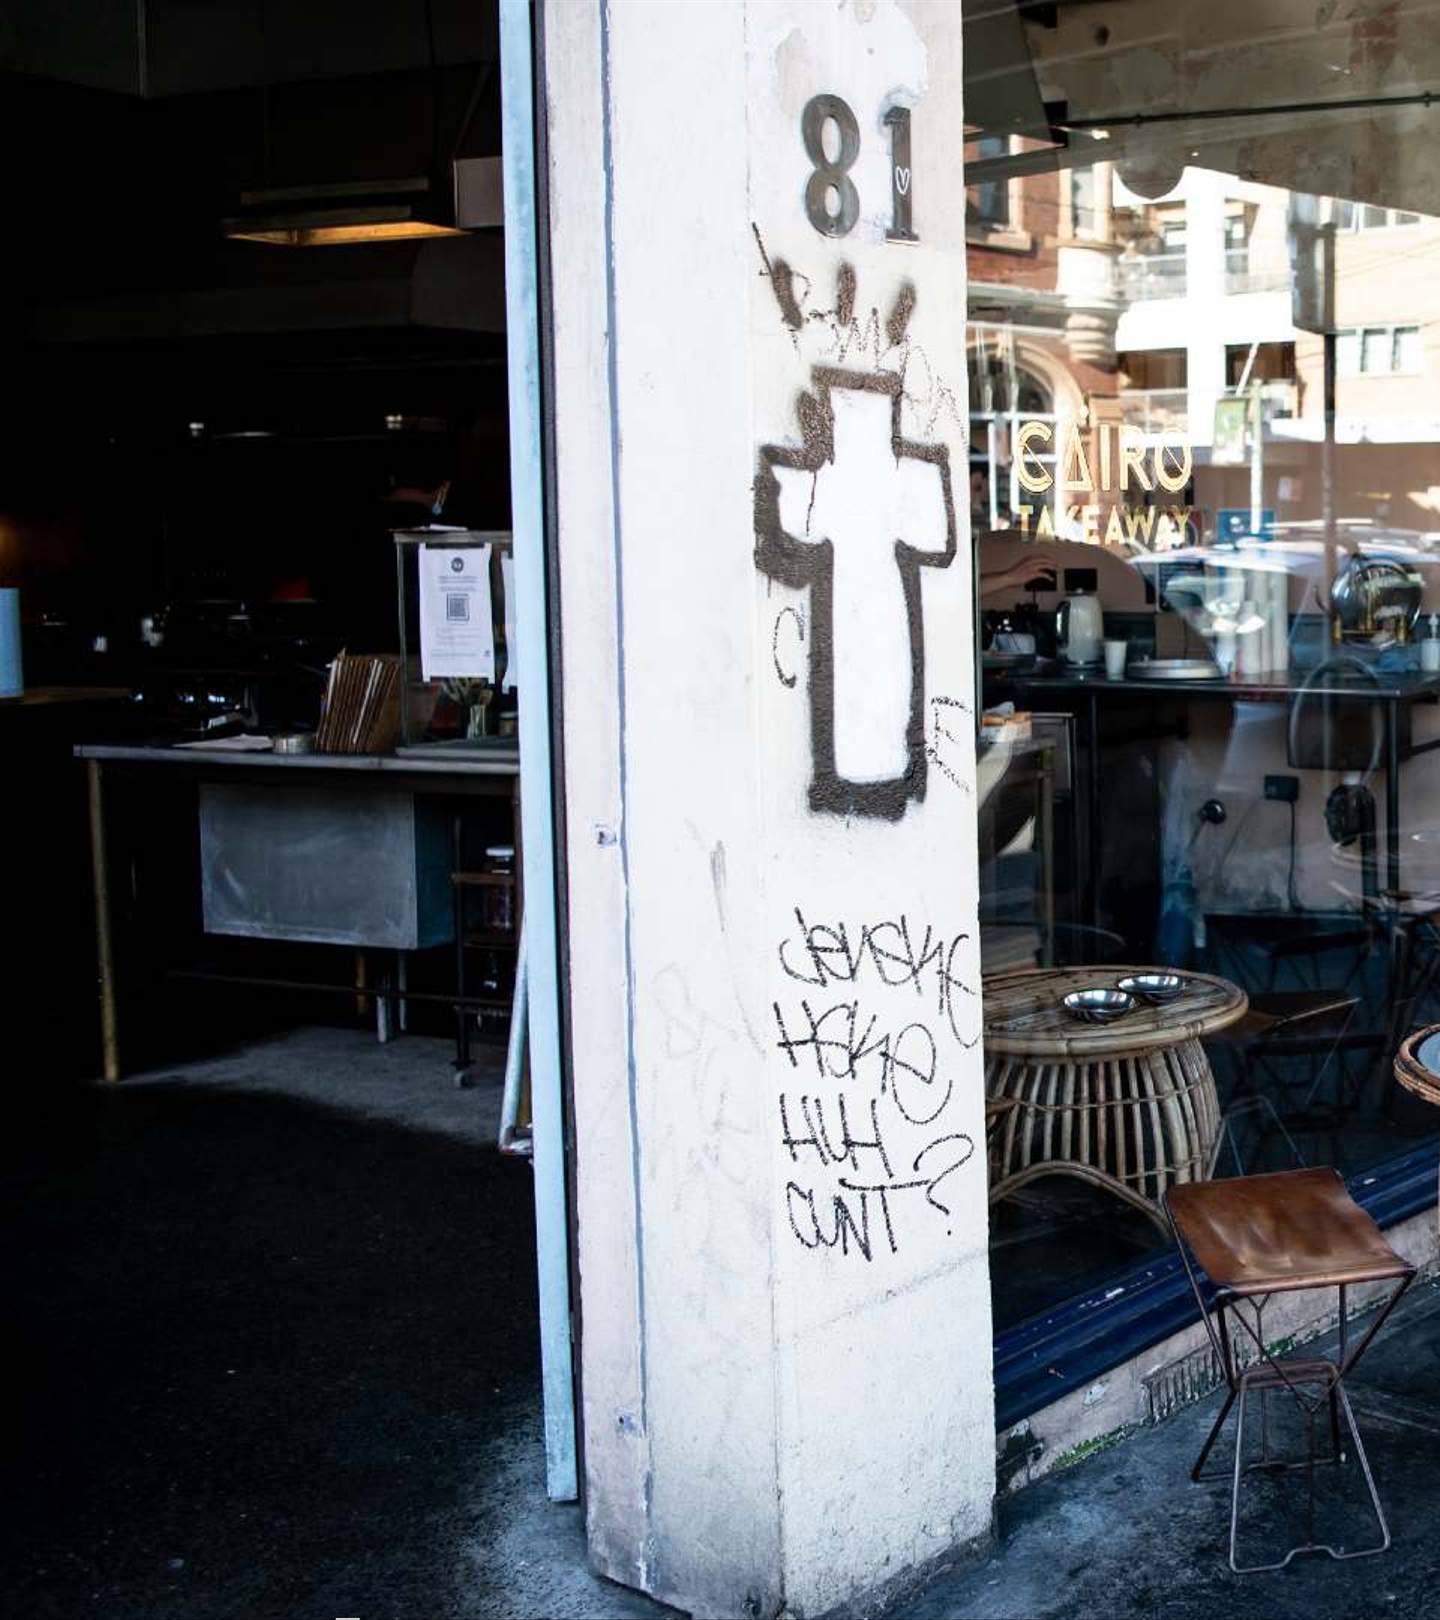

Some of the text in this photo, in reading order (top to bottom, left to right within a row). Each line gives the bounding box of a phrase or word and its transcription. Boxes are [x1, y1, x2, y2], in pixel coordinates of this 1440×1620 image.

[802, 93, 919, 246] 81
[1017, 420, 1193, 495] CAIRO
[1017, 504, 1192, 547] TAKEAWAY
